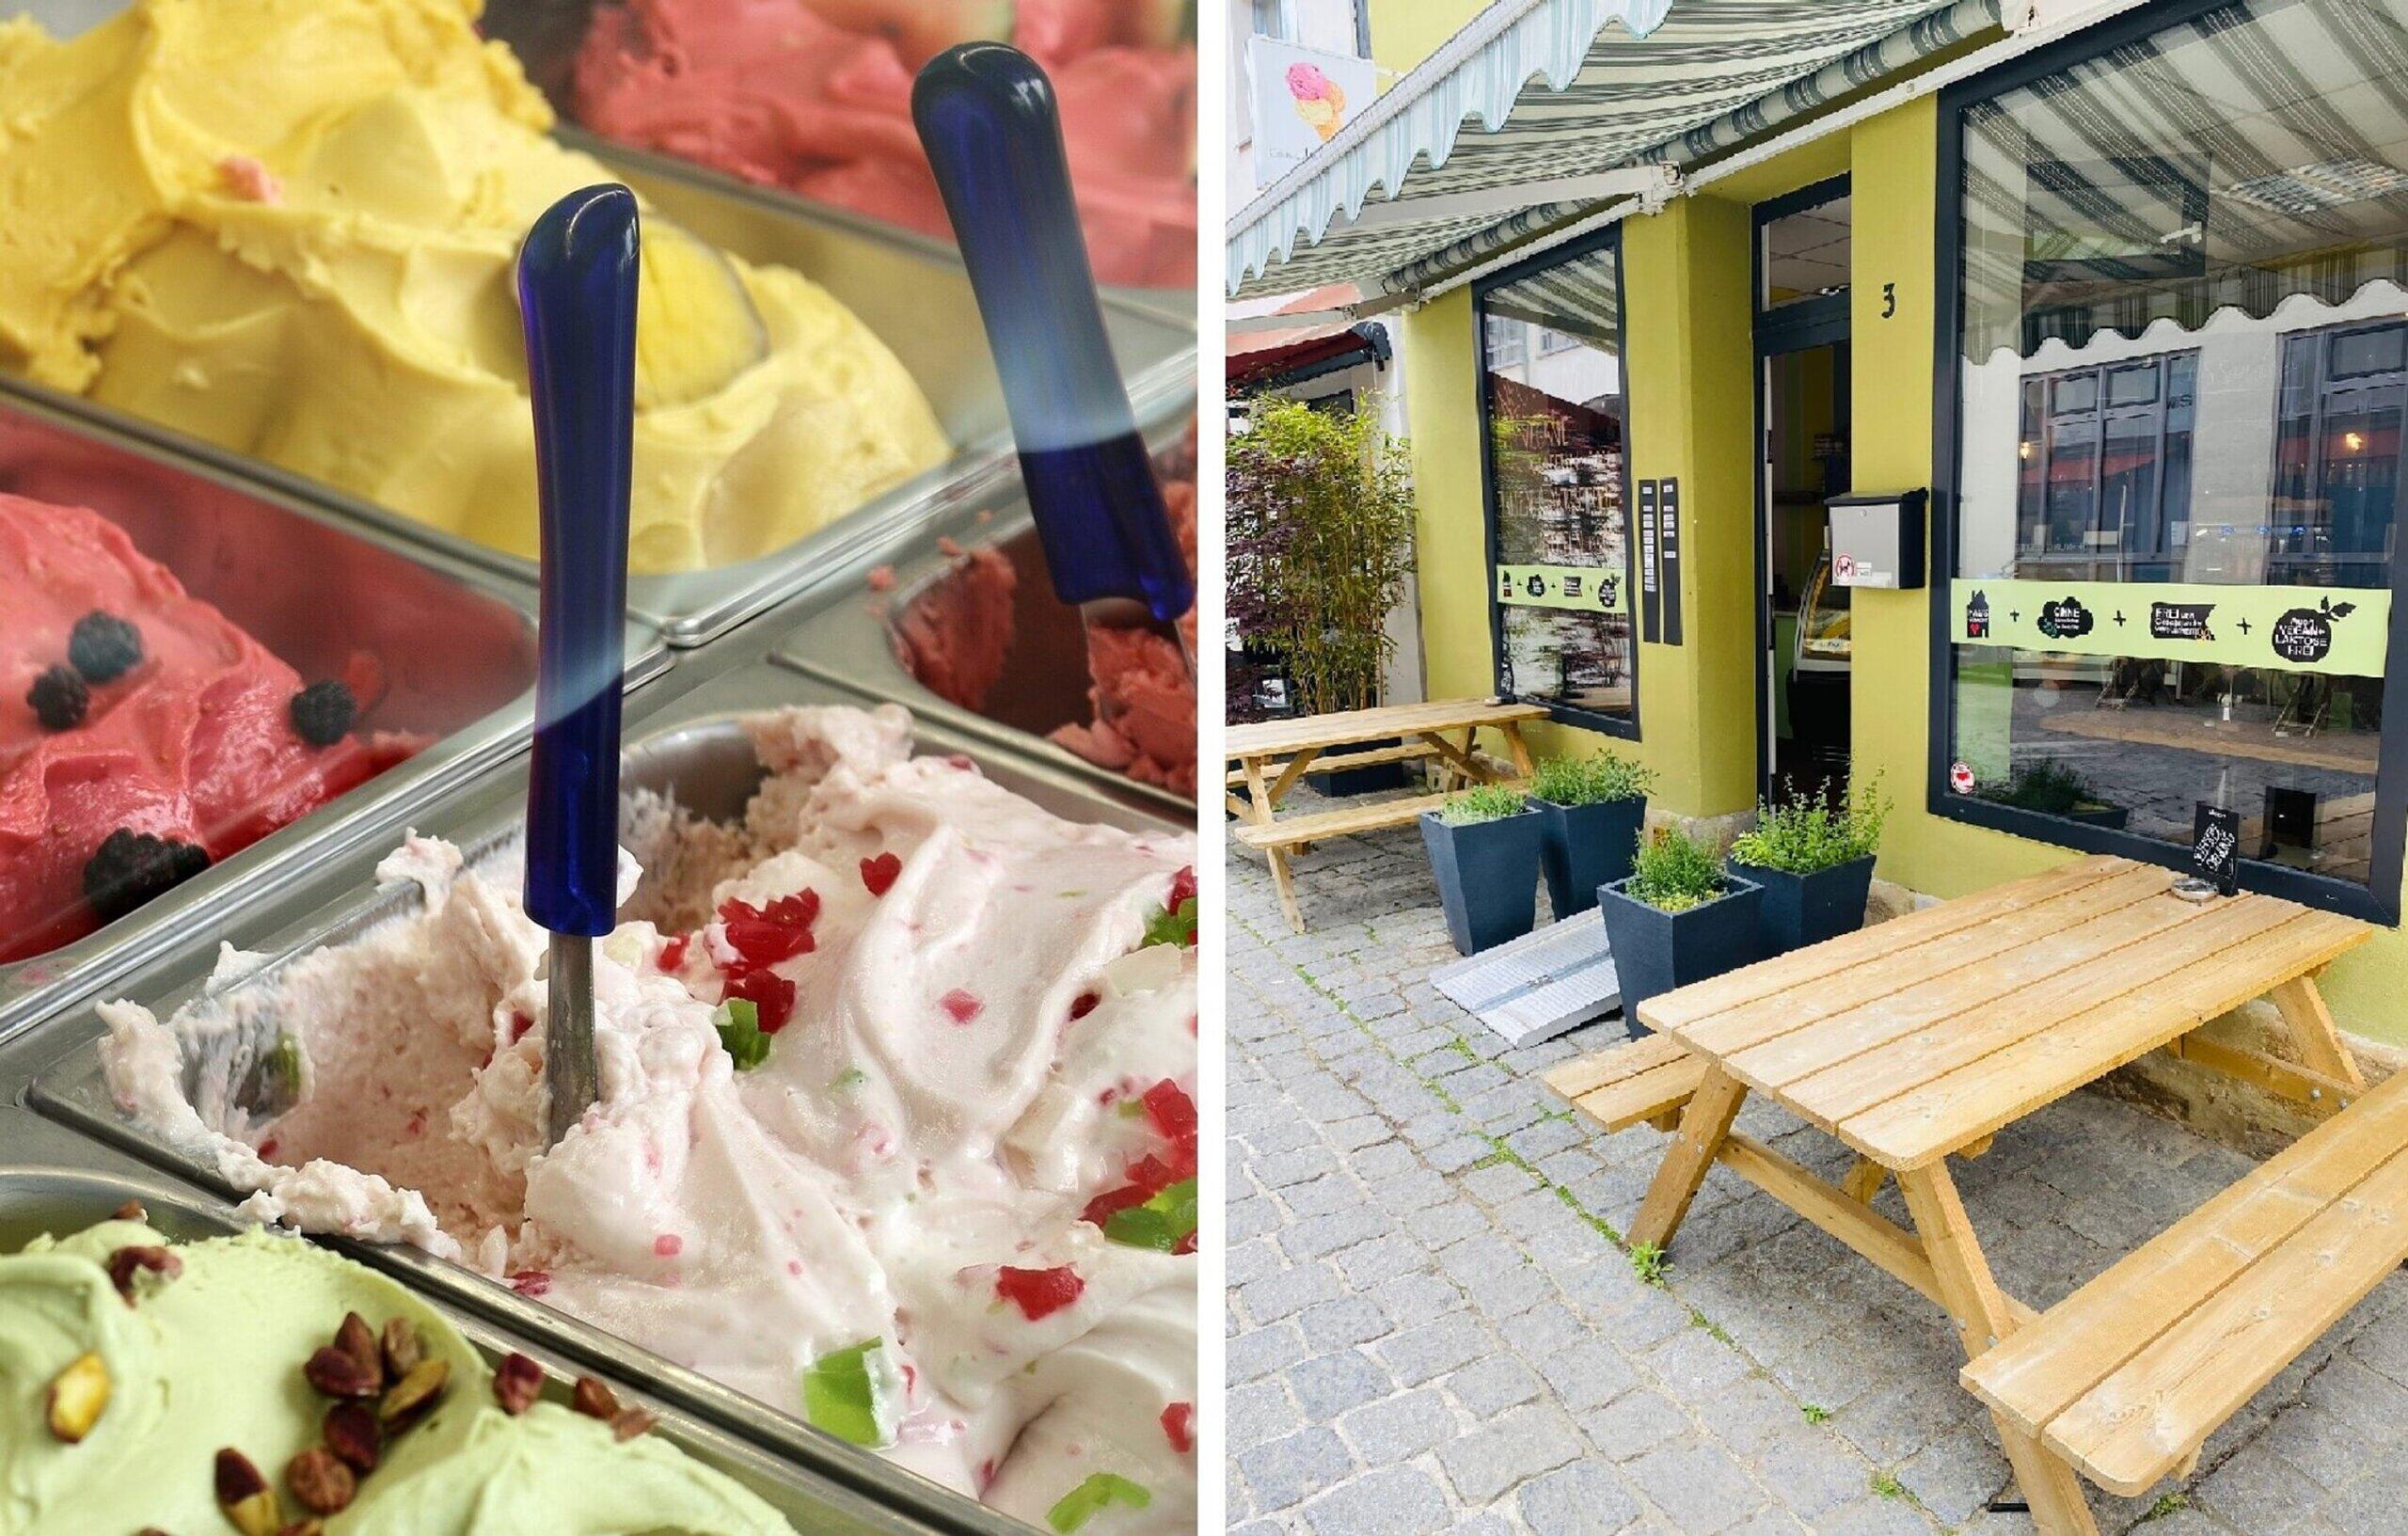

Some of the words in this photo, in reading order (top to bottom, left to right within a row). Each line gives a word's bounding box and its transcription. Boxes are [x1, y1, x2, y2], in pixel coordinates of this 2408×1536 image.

[1881, 282, 1895, 319] 3
[2275, 634, 2328, 647] LAKTOSE
[2288, 644, 2314, 657] FREI
